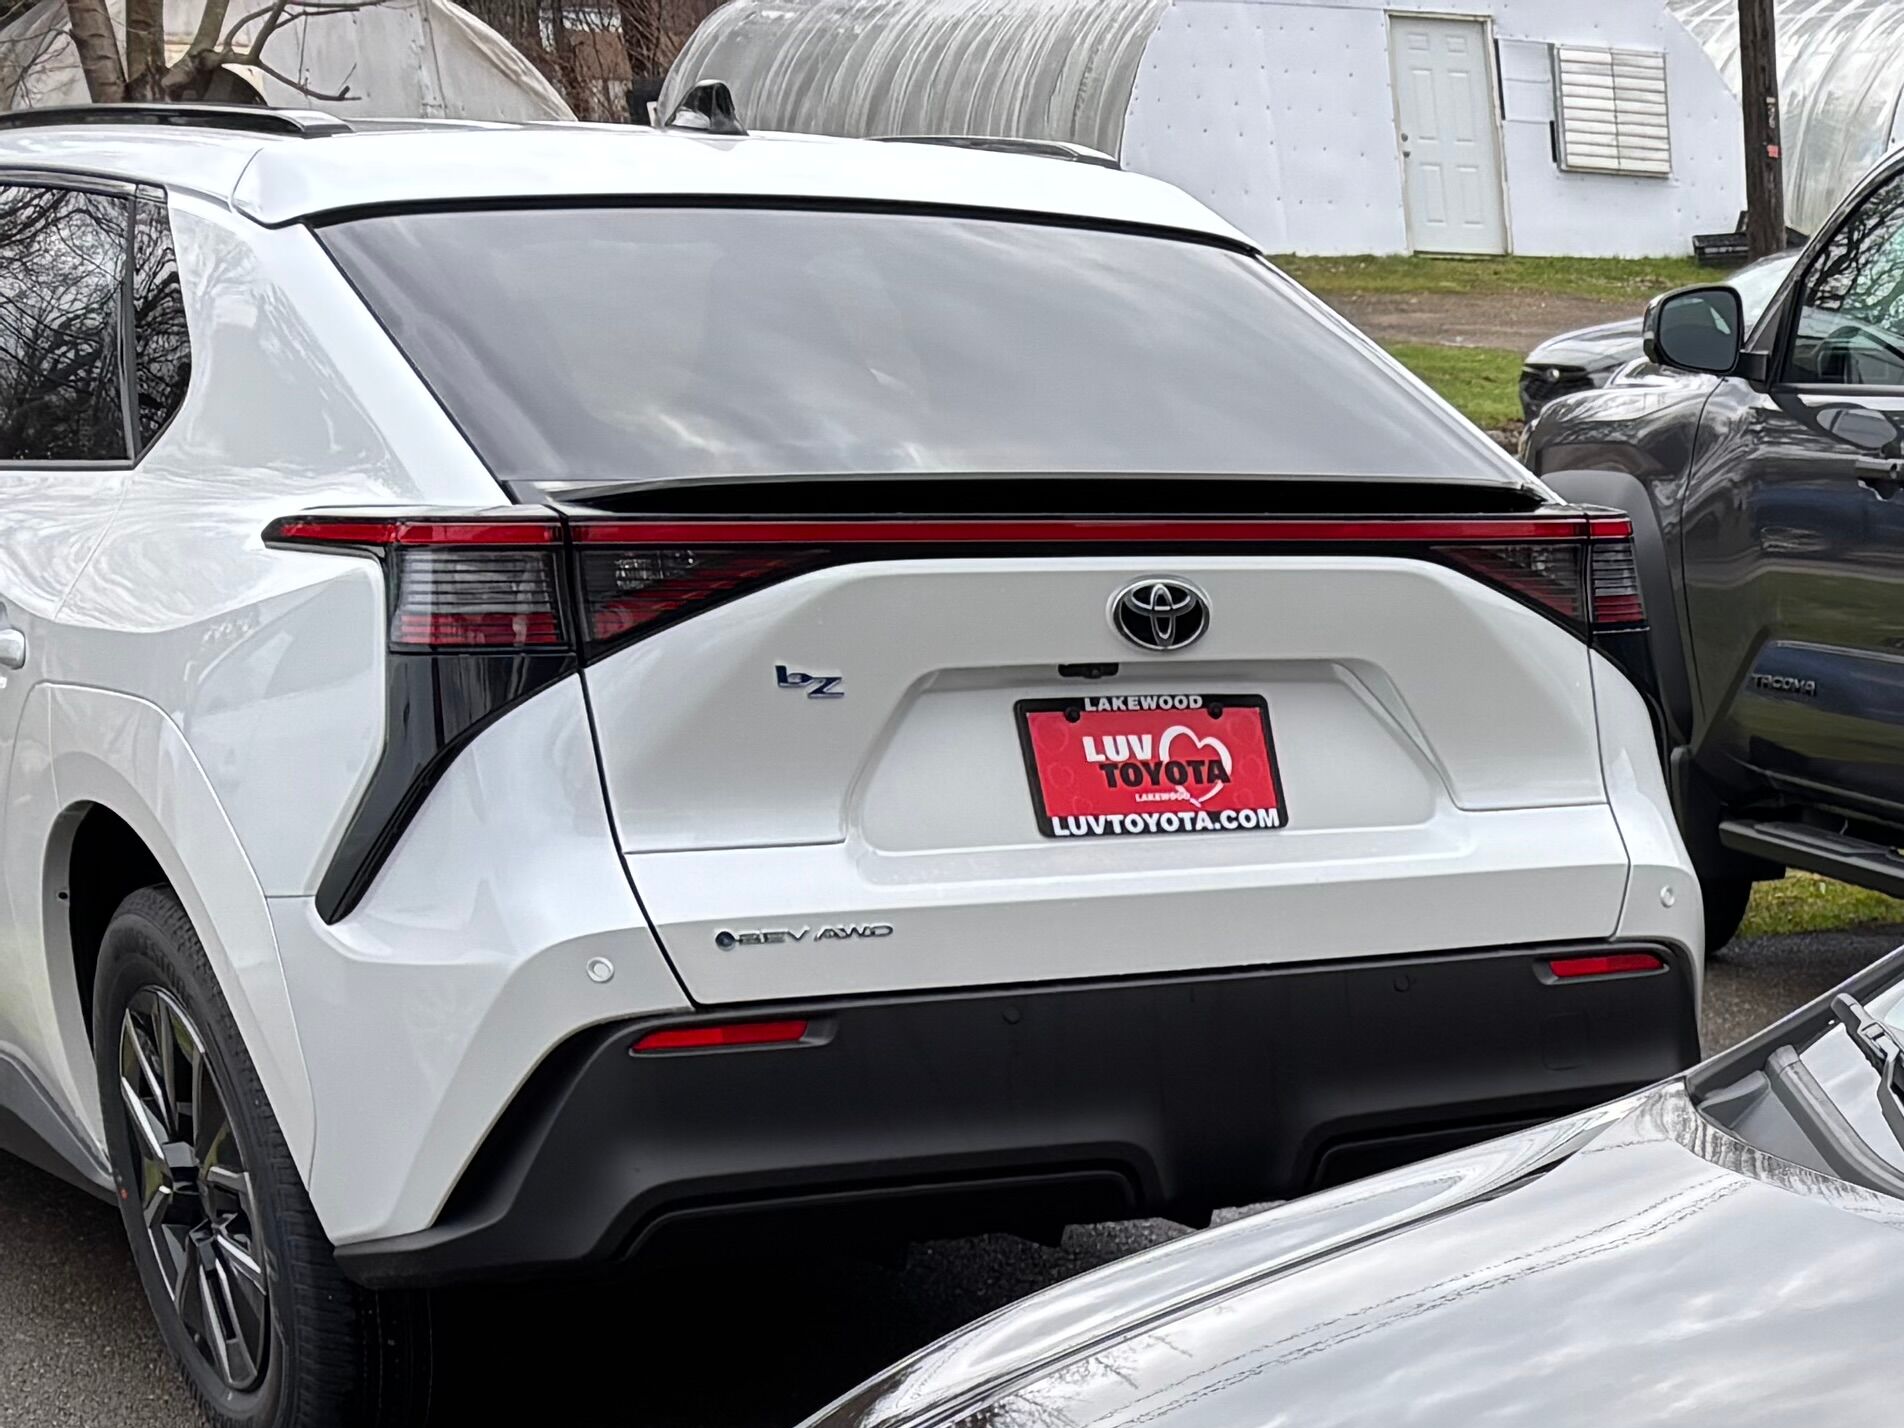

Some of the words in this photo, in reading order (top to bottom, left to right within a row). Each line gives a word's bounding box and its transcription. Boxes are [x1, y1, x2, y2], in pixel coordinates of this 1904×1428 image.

[1084, 695, 1203, 711] LAKEWOOD
[1082, 734, 1152, 762] LUV
[1099, 758, 1231, 788] TOYOTA
[1051, 807, 1280, 836] LUVTOYOTA.COM
[813, 924, 894, 942] AWD
